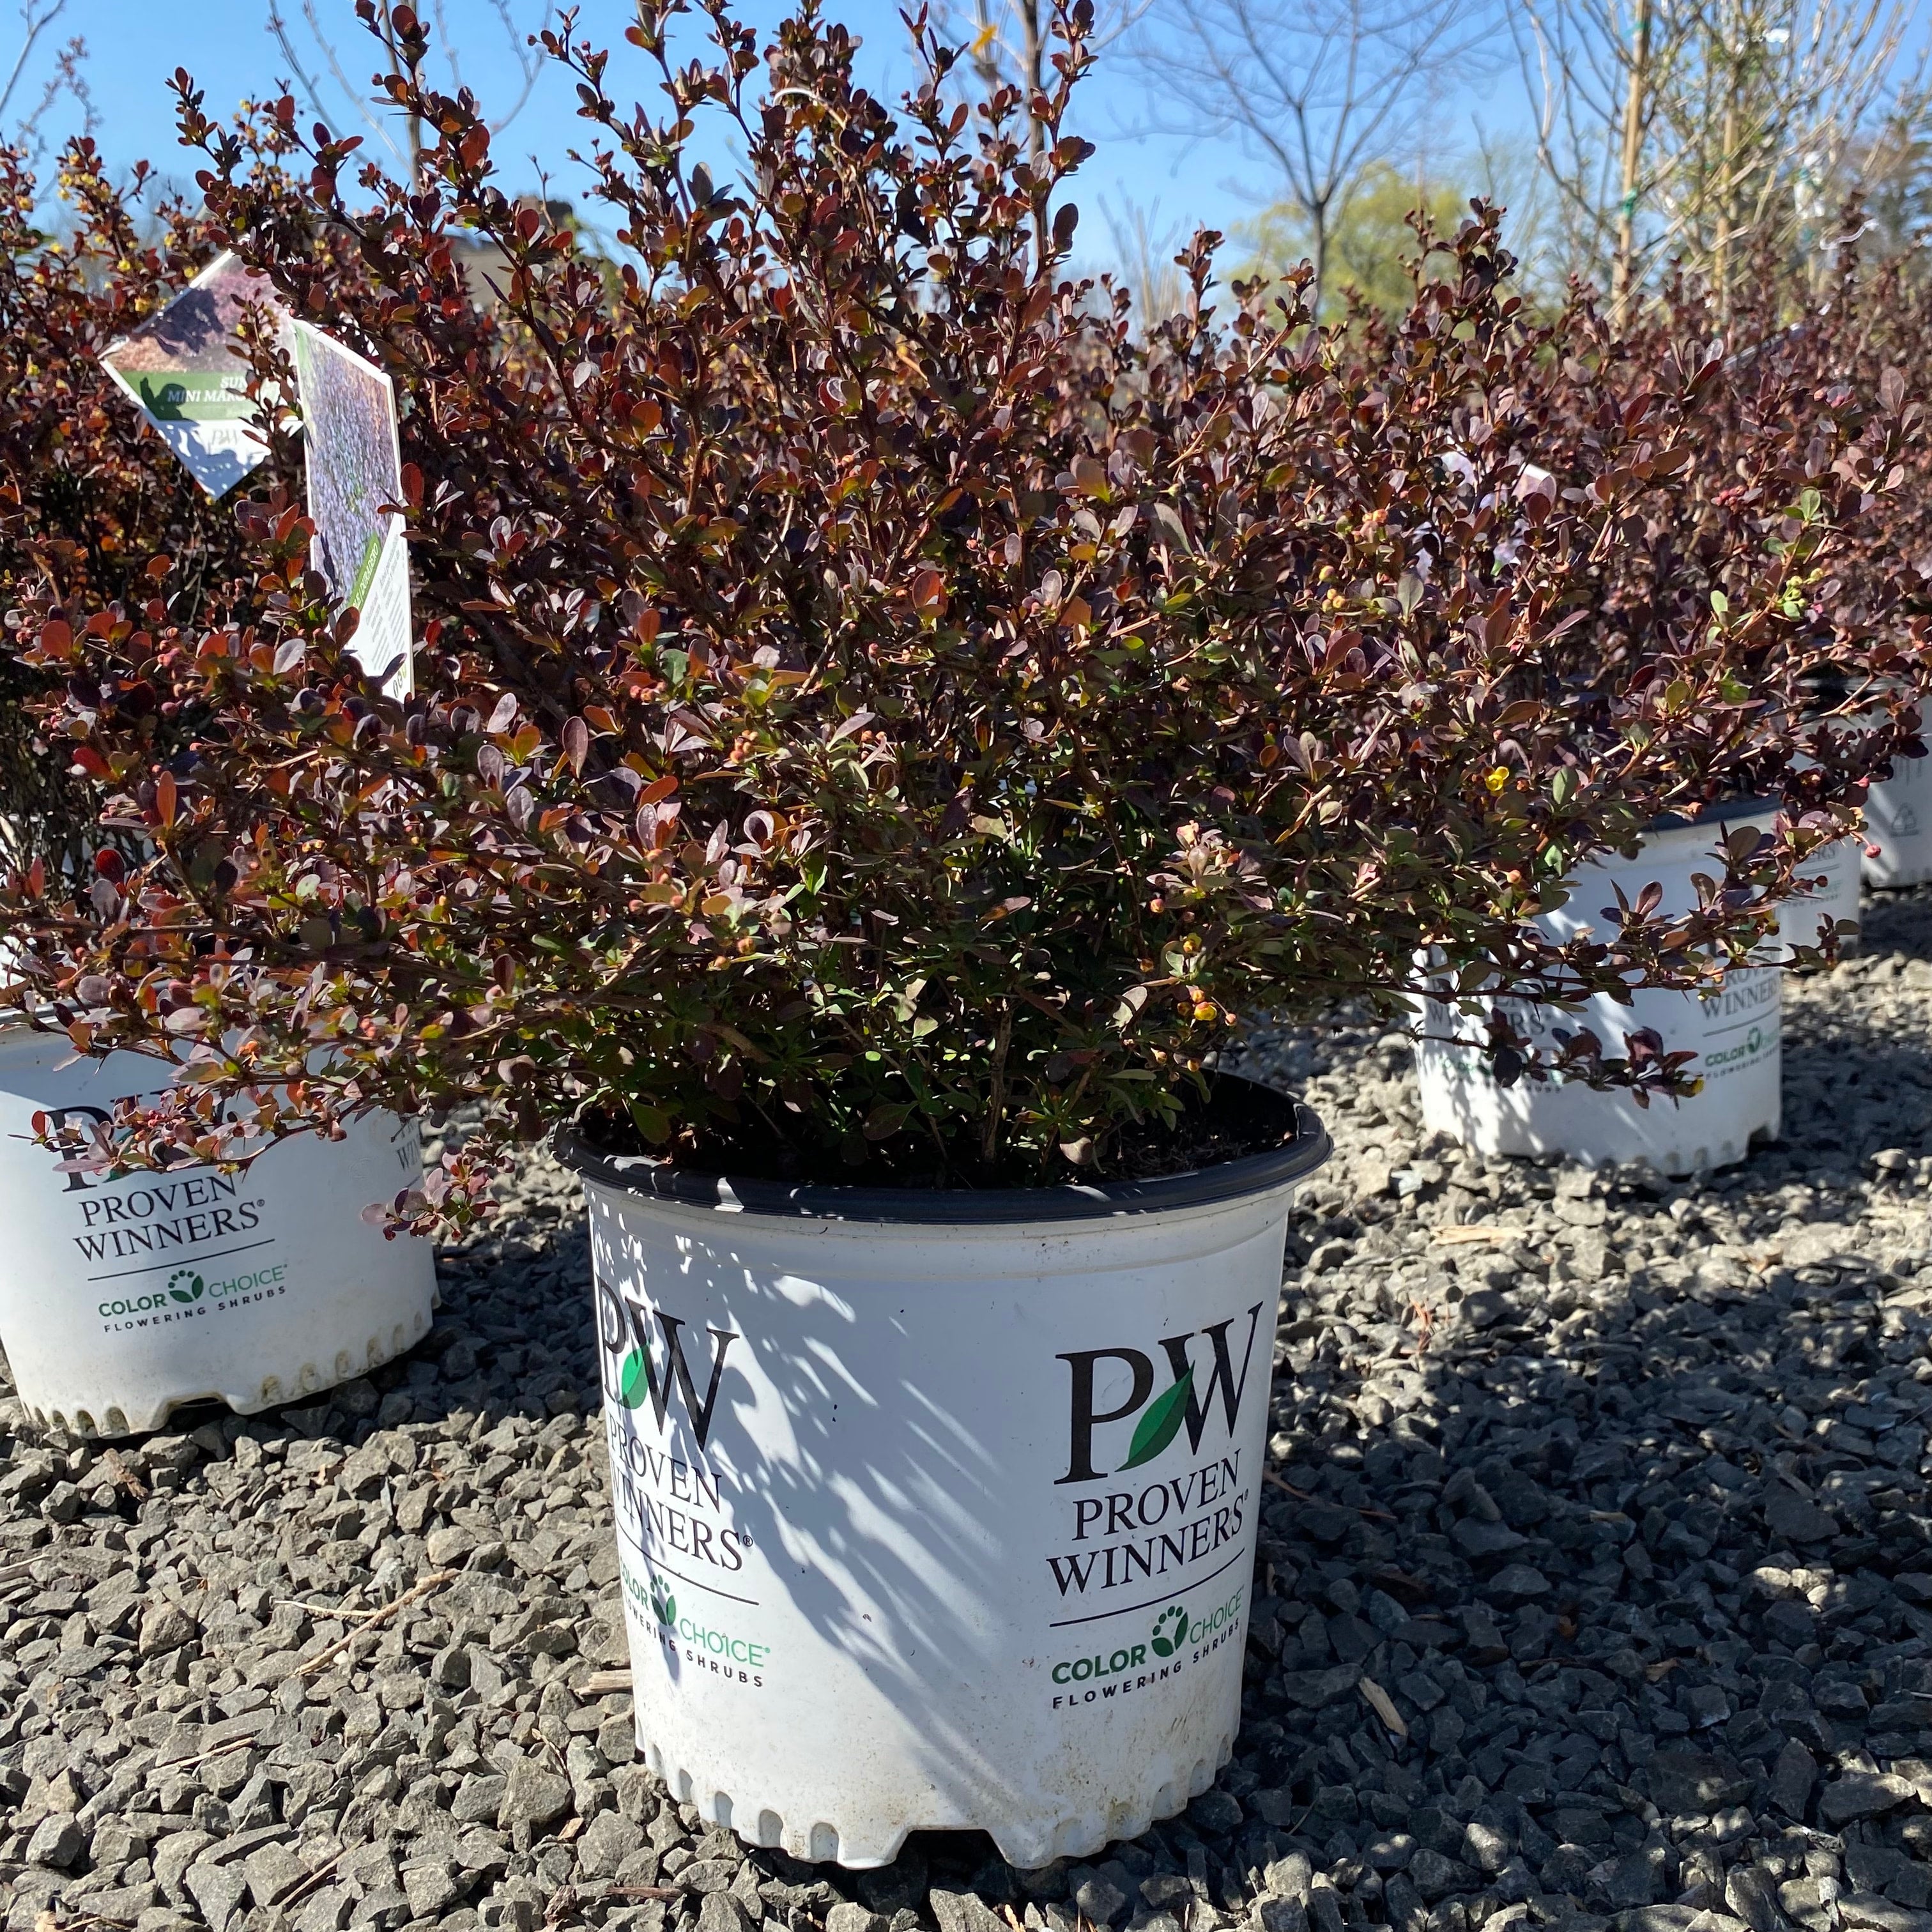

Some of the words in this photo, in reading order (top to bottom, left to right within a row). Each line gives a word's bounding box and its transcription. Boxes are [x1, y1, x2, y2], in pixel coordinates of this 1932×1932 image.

[168, 389, 201, 402] MINI
[78, 1174, 236, 1227] PROVEN
[98, 1293, 168, 1317] COLOR
[104, 1307, 206, 1332] FLOWERING
[218, 1285, 286, 1310] SHRUBS
[1054, 1301, 1264, 1485] PW
[608, 1411, 722, 1514] PROVEN
[1071, 1448, 1241, 1541] PROVEN
[621, 1562, 649, 1611] OLOR
[686, 1649, 763, 1687] SHRUBS
[1052, 1660, 1182, 1709] FLOWERING
[1193, 1617, 1239, 1664] SHRUBS
[1052, 1643, 1147, 1685] COLOR
